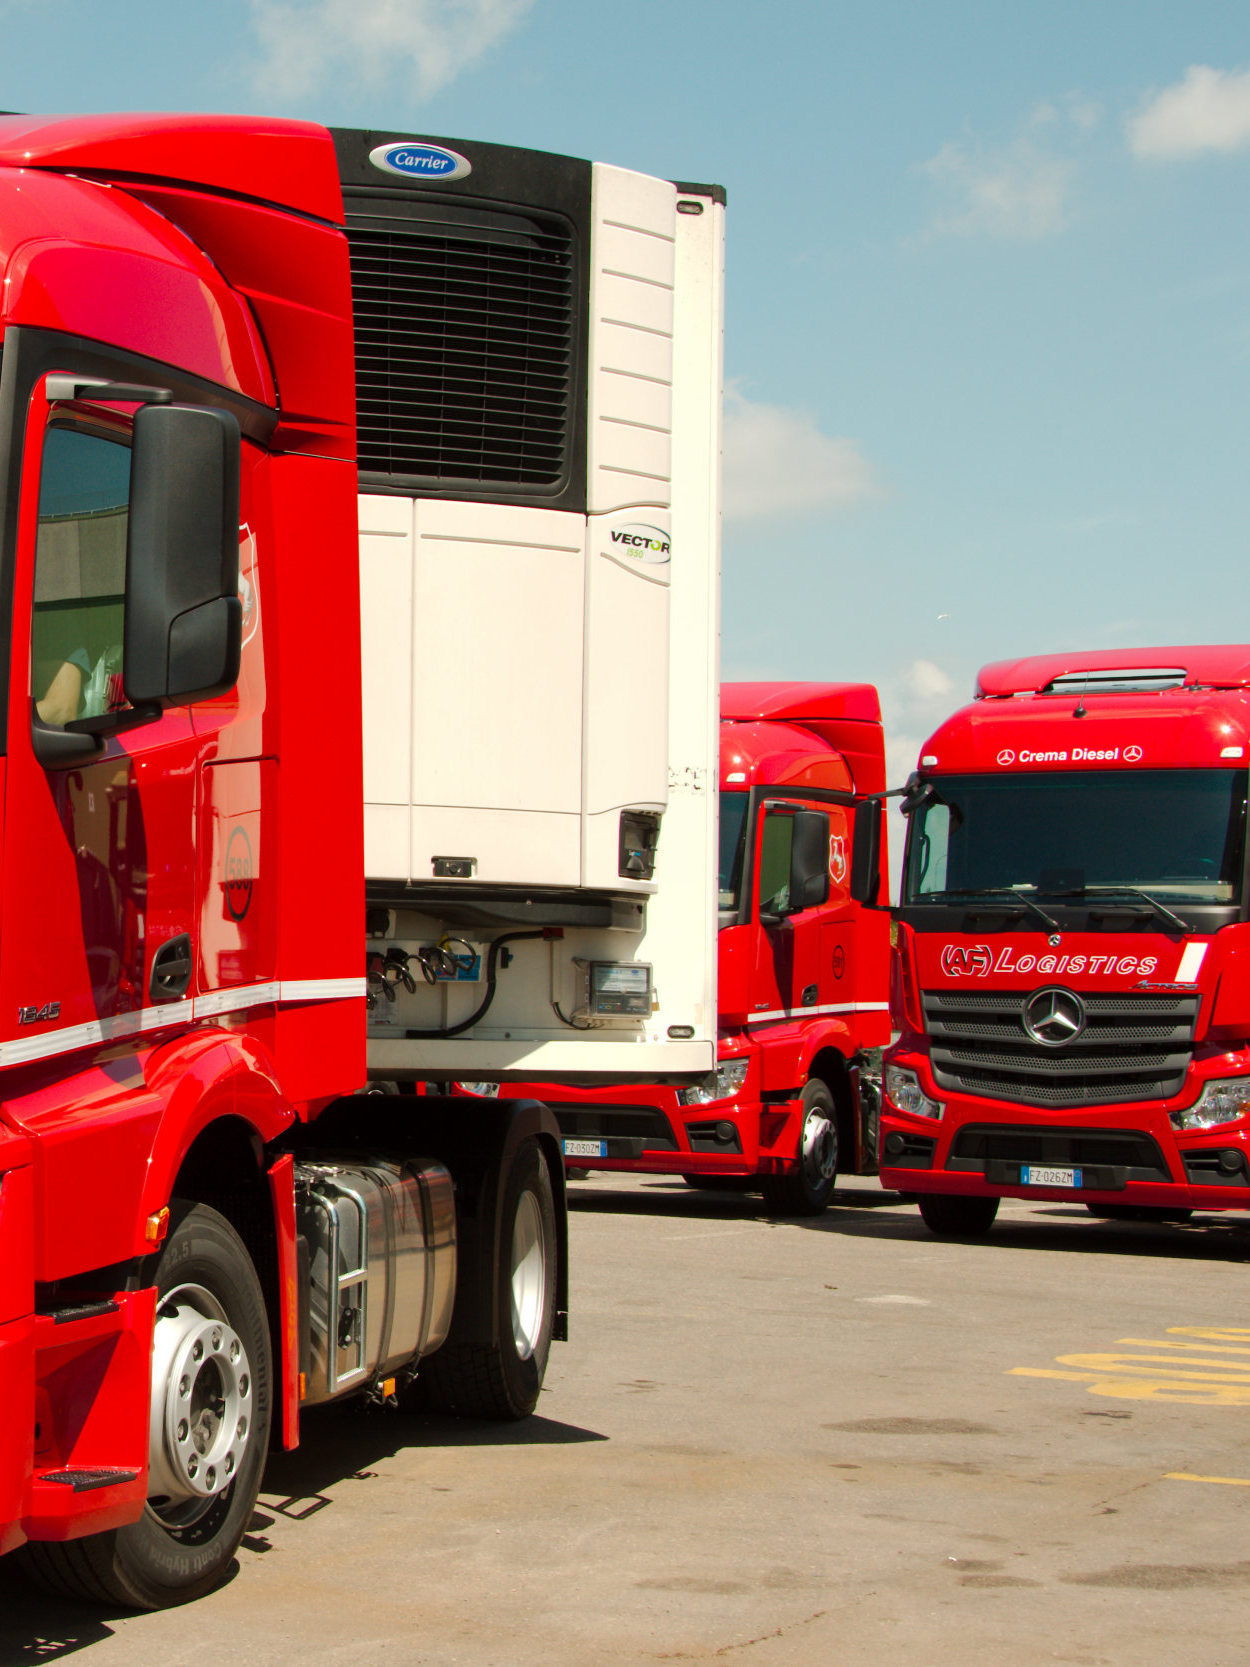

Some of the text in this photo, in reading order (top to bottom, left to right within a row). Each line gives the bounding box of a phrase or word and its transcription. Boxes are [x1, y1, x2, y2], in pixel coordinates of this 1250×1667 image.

[394, 151, 449, 170] Carrier
[610, 530, 671, 554] VECTOR
[1018, 747, 1119, 763] Crema Diesel
[229, 856, 250, 891] 588
[993, 947, 1158, 975] LOGISTICS
[18, 1001, 61, 1024] 1845
